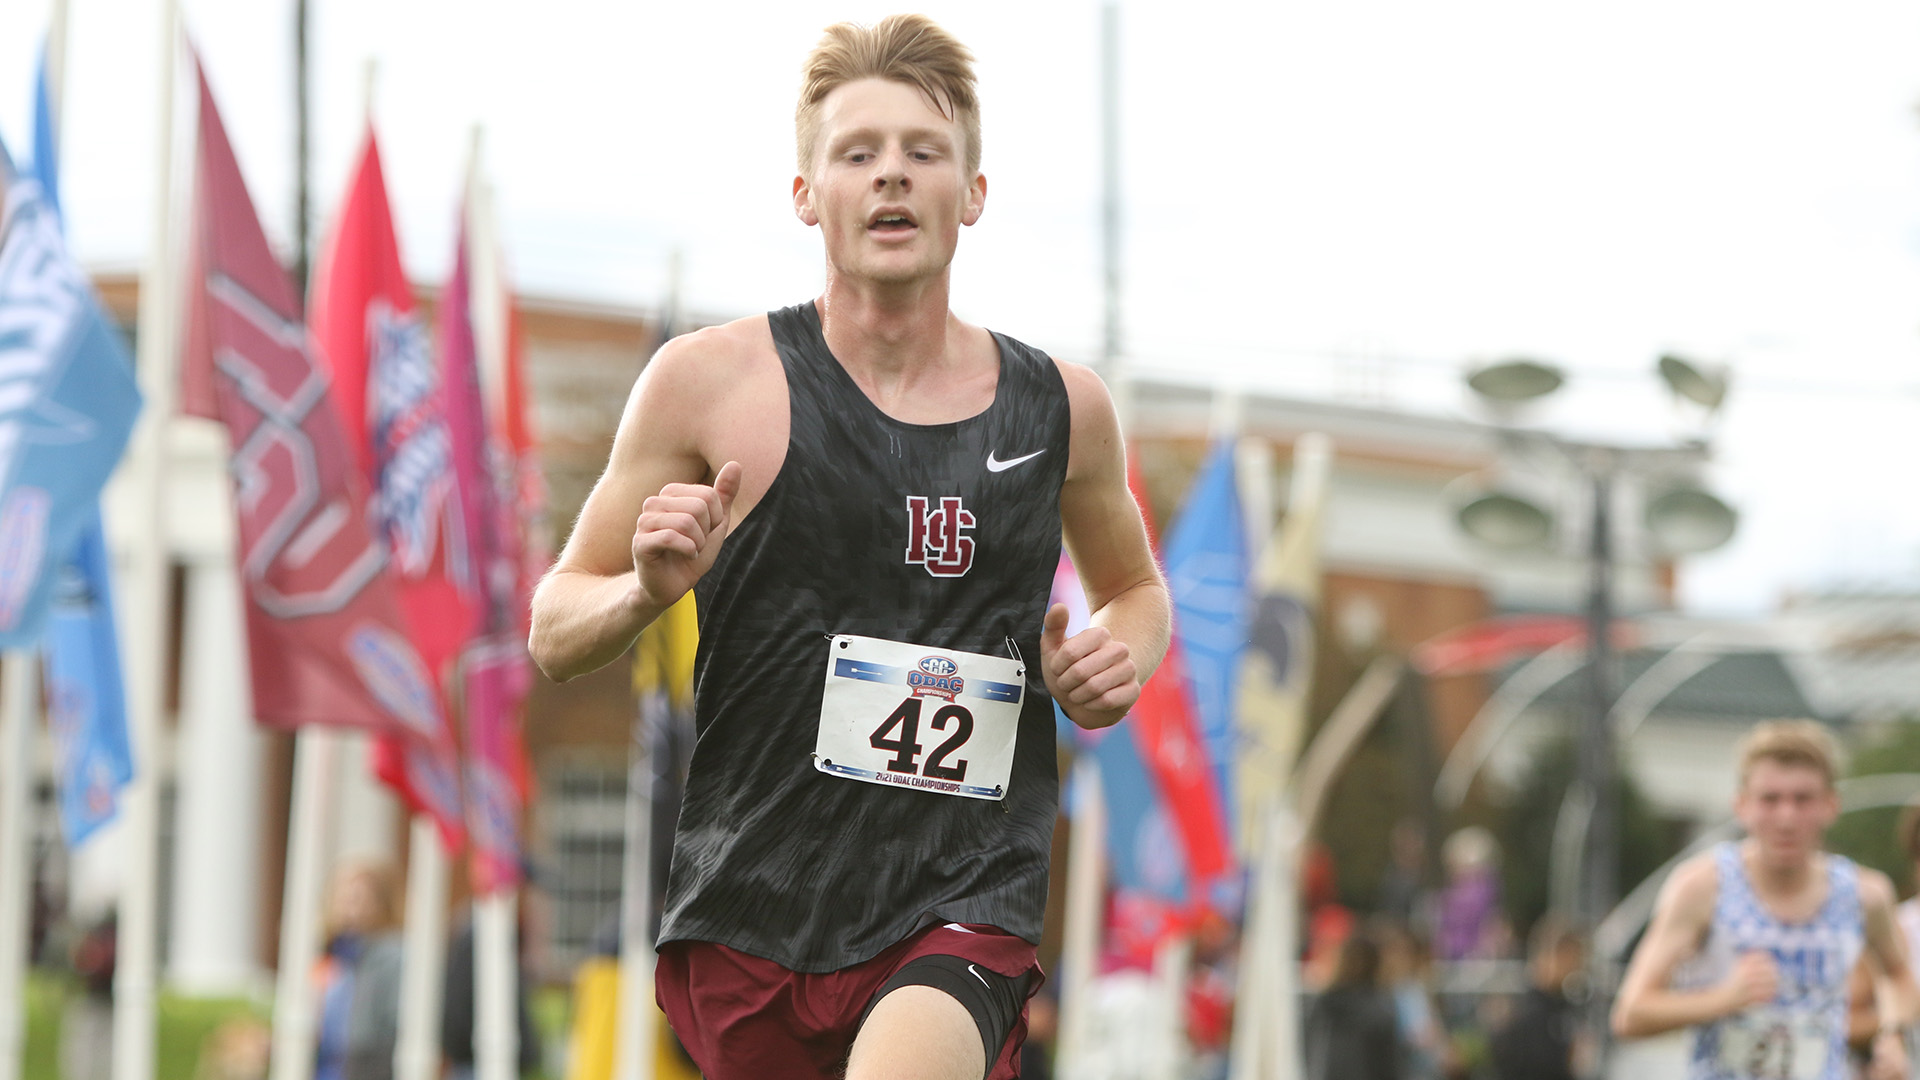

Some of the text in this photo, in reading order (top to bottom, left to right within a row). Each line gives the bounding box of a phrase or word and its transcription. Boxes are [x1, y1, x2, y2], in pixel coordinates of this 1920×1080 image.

[909, 671, 963, 692] ODAC
[869, 697, 974, 782] 42
[911, 777, 961, 793] CHAMPIONSHIPS
